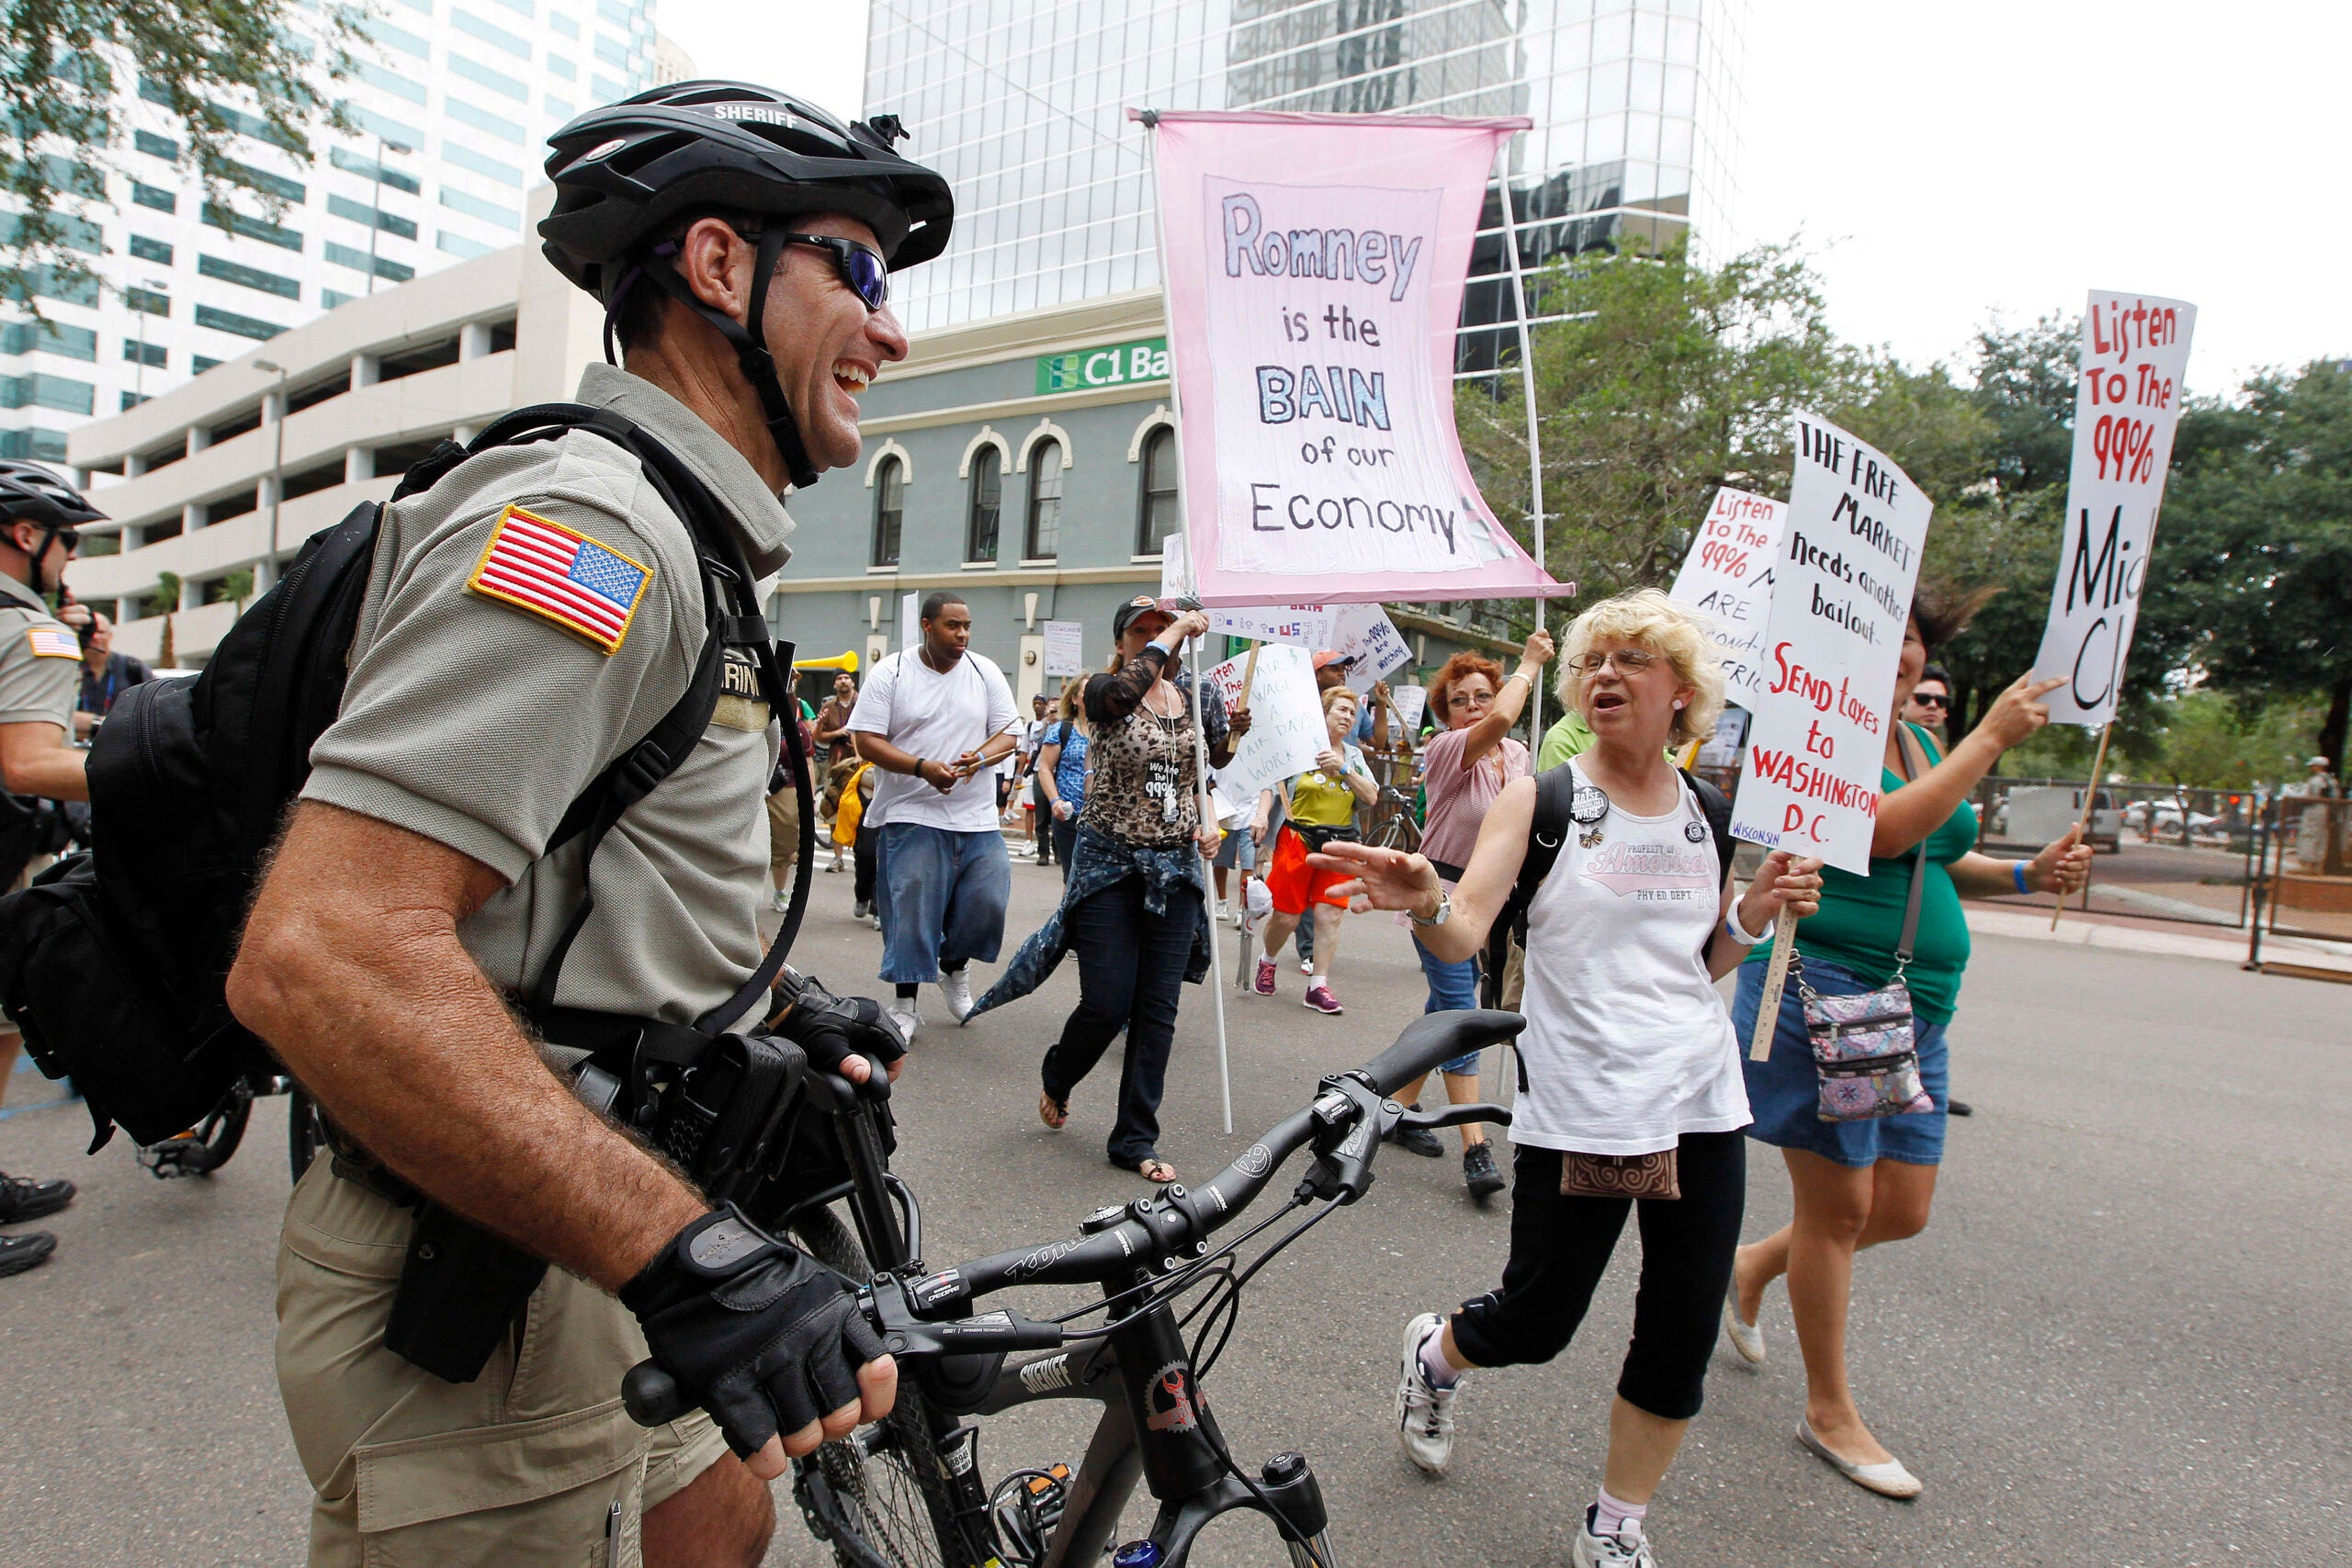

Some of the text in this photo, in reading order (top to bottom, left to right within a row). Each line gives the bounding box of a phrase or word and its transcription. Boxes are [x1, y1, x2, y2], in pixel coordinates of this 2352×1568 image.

[715, 105, 797, 129] SHERIFF
[1221, 193, 1423, 301] Romney
[1283, 305, 1381, 347] is the
[2091, 299, 2177, 364] Listen
[1085, 349, 1124, 385] C1
[2086, 364, 2172, 410] To The
[1256, 366, 1392, 431] BAIN
[1302, 435, 1396, 468] of our
[1798, 421, 1900, 509] THE FREE
[2093, 414, 2155, 484] 99%
[1251, 483, 1456, 554] Economy
[1716, 493, 1774, 521] Listen
[1706, 520, 1768, 549] To The
[1832, 491, 1916, 573] MARKET
[1701, 540, 1749, 579] 99%
[1790, 531, 1854, 584] needs
[1859, 571, 1905, 623] another
[1698, 590, 1751, 621] ARE
[1207, 661, 1236, 688] isten
[1769, 641, 1880, 735] SEND taxes
[1806, 719, 1835, 759] to
[1154, 773, 1166, 782] The
[1752, 744, 1880, 819] WASHINGTON
[1627, 844, 1663, 853] PROPERTY
[1733, 821, 1781, 846] WISCONSIN
[1587, 841, 1707, 874] America
[1019, 1352, 1073, 1394] SHERIFF
